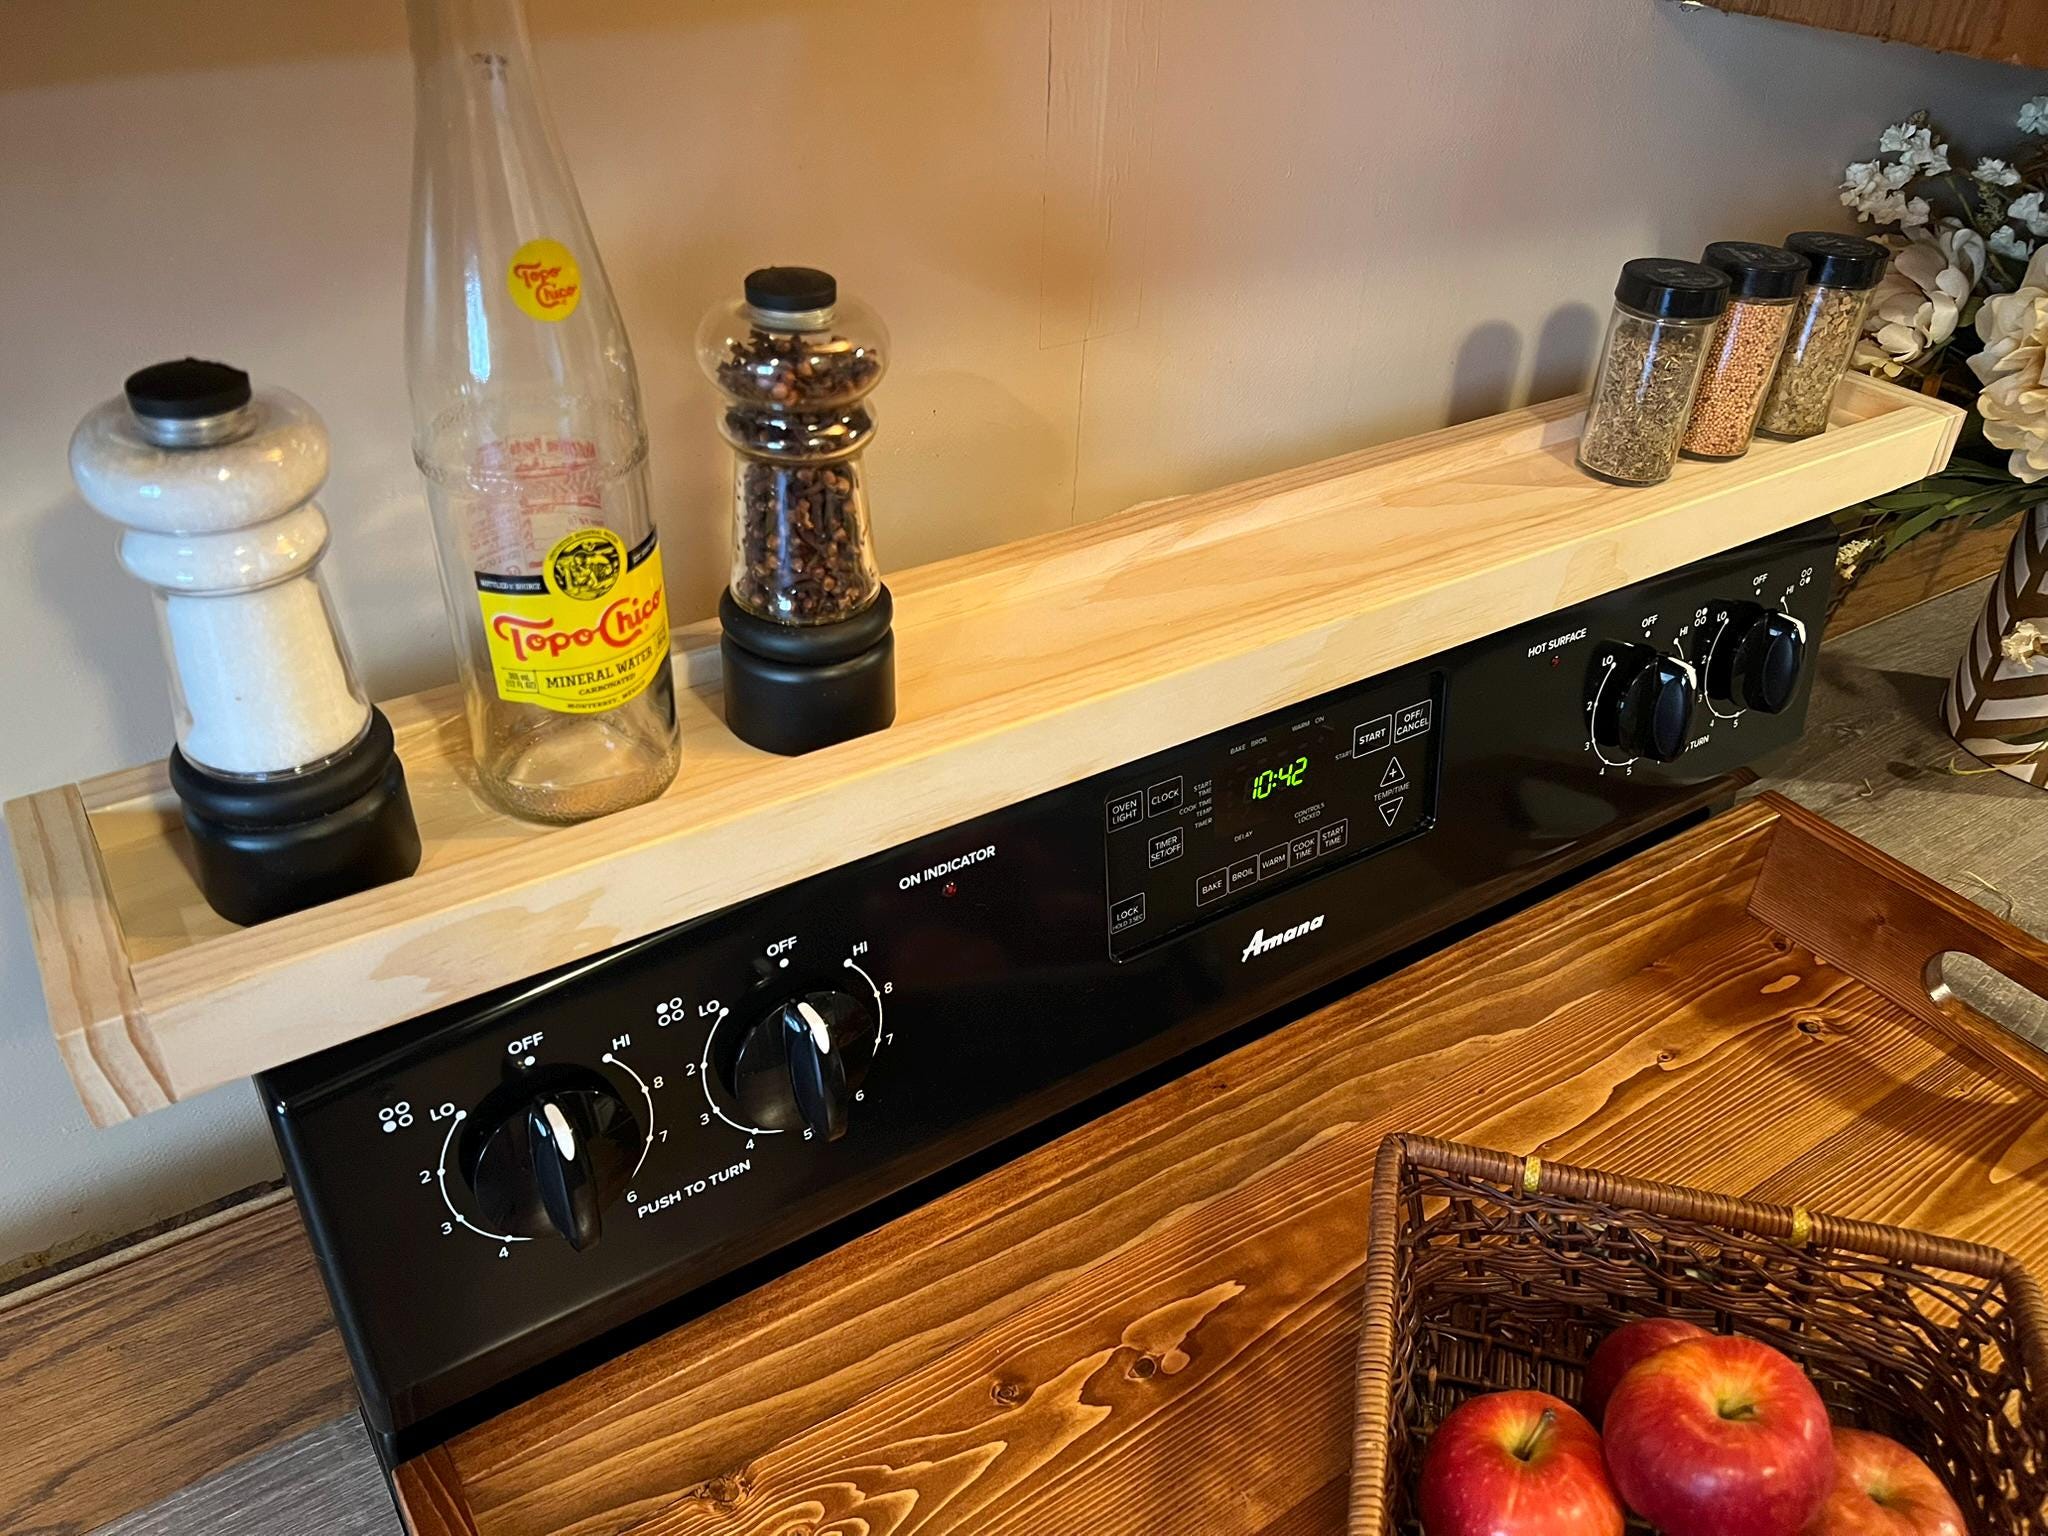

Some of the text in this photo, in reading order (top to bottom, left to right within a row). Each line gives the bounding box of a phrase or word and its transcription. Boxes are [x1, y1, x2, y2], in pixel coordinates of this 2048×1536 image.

[513, 261, 562, 289] Topo
[535, 283, 578, 308] Chico
[1752, 572, 1769, 587] OFF
[1785, 584, 1795, 595] HI
[493, 614, 594, 662] Topo
[599, 584, 663, 648] Chico
[1641, 614, 1659, 628] OFF
[1716, 611, 1728, 622] LO
[1679, 626, 1689, 637] HI
[1527, 628, 1588, 658] HOT SURFACE
[1602, 655, 1614, 667] LO
[1701, 655, 1707, 664] 2
[545, 666, 614, 689] MINERAL
[615, 645, 653, 675] WATER
[1586, 701, 1593, 712] 2
[1314, 716, 1325, 725] ON
[1404, 708, 1424, 723] OFF/
[1396, 717, 1429, 736] CANCEL
[1732, 719, 1738, 728] 5
[1359, 728, 1387, 745] START
[1689, 734, 1711, 750] TURN
[1230, 743, 1247, 755] BAKE
[1584, 741, 1590, 751] 3
[1335, 750, 1353, 760] START
[1252, 756, 1308, 800] 10:42
[1626, 766, 1632, 776] 5
[1193, 780, 1212, 792] START
[1198, 787, 1212, 798] TIME
[1374, 781, 1411, 802] TEMP/TIME
[1151, 788, 1180, 806] CLOCK
[1112, 799, 1138, 815] OVEN
[1179, 797, 1212, 816] COOK TIME
[1196, 806, 1213, 818] TEMP
[1294, 802, 1326, 820] CONTROLS
[1112, 808, 1138, 825] LIGHT
[1194, 817, 1213, 830] TIMER
[1298, 810, 1321, 824] LOCKED
[1234, 830, 1254, 843] DELAY
[1322, 825, 1344, 841] START
[1154, 835, 1178, 851] TIMER
[1292, 837, 1316, 853] COOK
[1324, 835, 1342, 848] TIME
[1150, 842, 1181, 862] SET/OFF
[1296, 848, 1313, 861] TIME
[898, 845, 996, 890] ON INDICATOR
[1262, 854, 1286, 869] WARM
[1232, 868, 1255, 882] BROIL
[1202, 880, 1223, 895] BAKE
[1116, 906, 1139, 922] LOCK
[1241, 914, 1325, 963] Amana
[766, 936, 798, 958] OFF
[852, 941, 868, 956] HI
[884, 982, 894, 994] 8
[698, 1000, 720, 1018] LO
[507, 1031, 545, 1056] OFF
[612, 1034, 631, 1051] HI
[886, 1033, 894, 1046] 7
[685, 1063, 696, 1077] 2
[653, 1076, 664, 1090] 8
[854, 1090, 865, 1102] 6
[430, 1102, 456, 1122] LO
[700, 1112, 710, 1126] 3
[658, 1130, 668, 1143] 7
[803, 1127, 814, 1141] 5
[745, 1138, 756, 1151] 4
[418, 1170, 432, 1185] 2
[637, 1159, 752, 1219] PUSH TO TURN
[626, 1190, 638, 1204] 6
[440, 1222, 453, 1236] 3
[498, 1246, 510, 1260] 4
